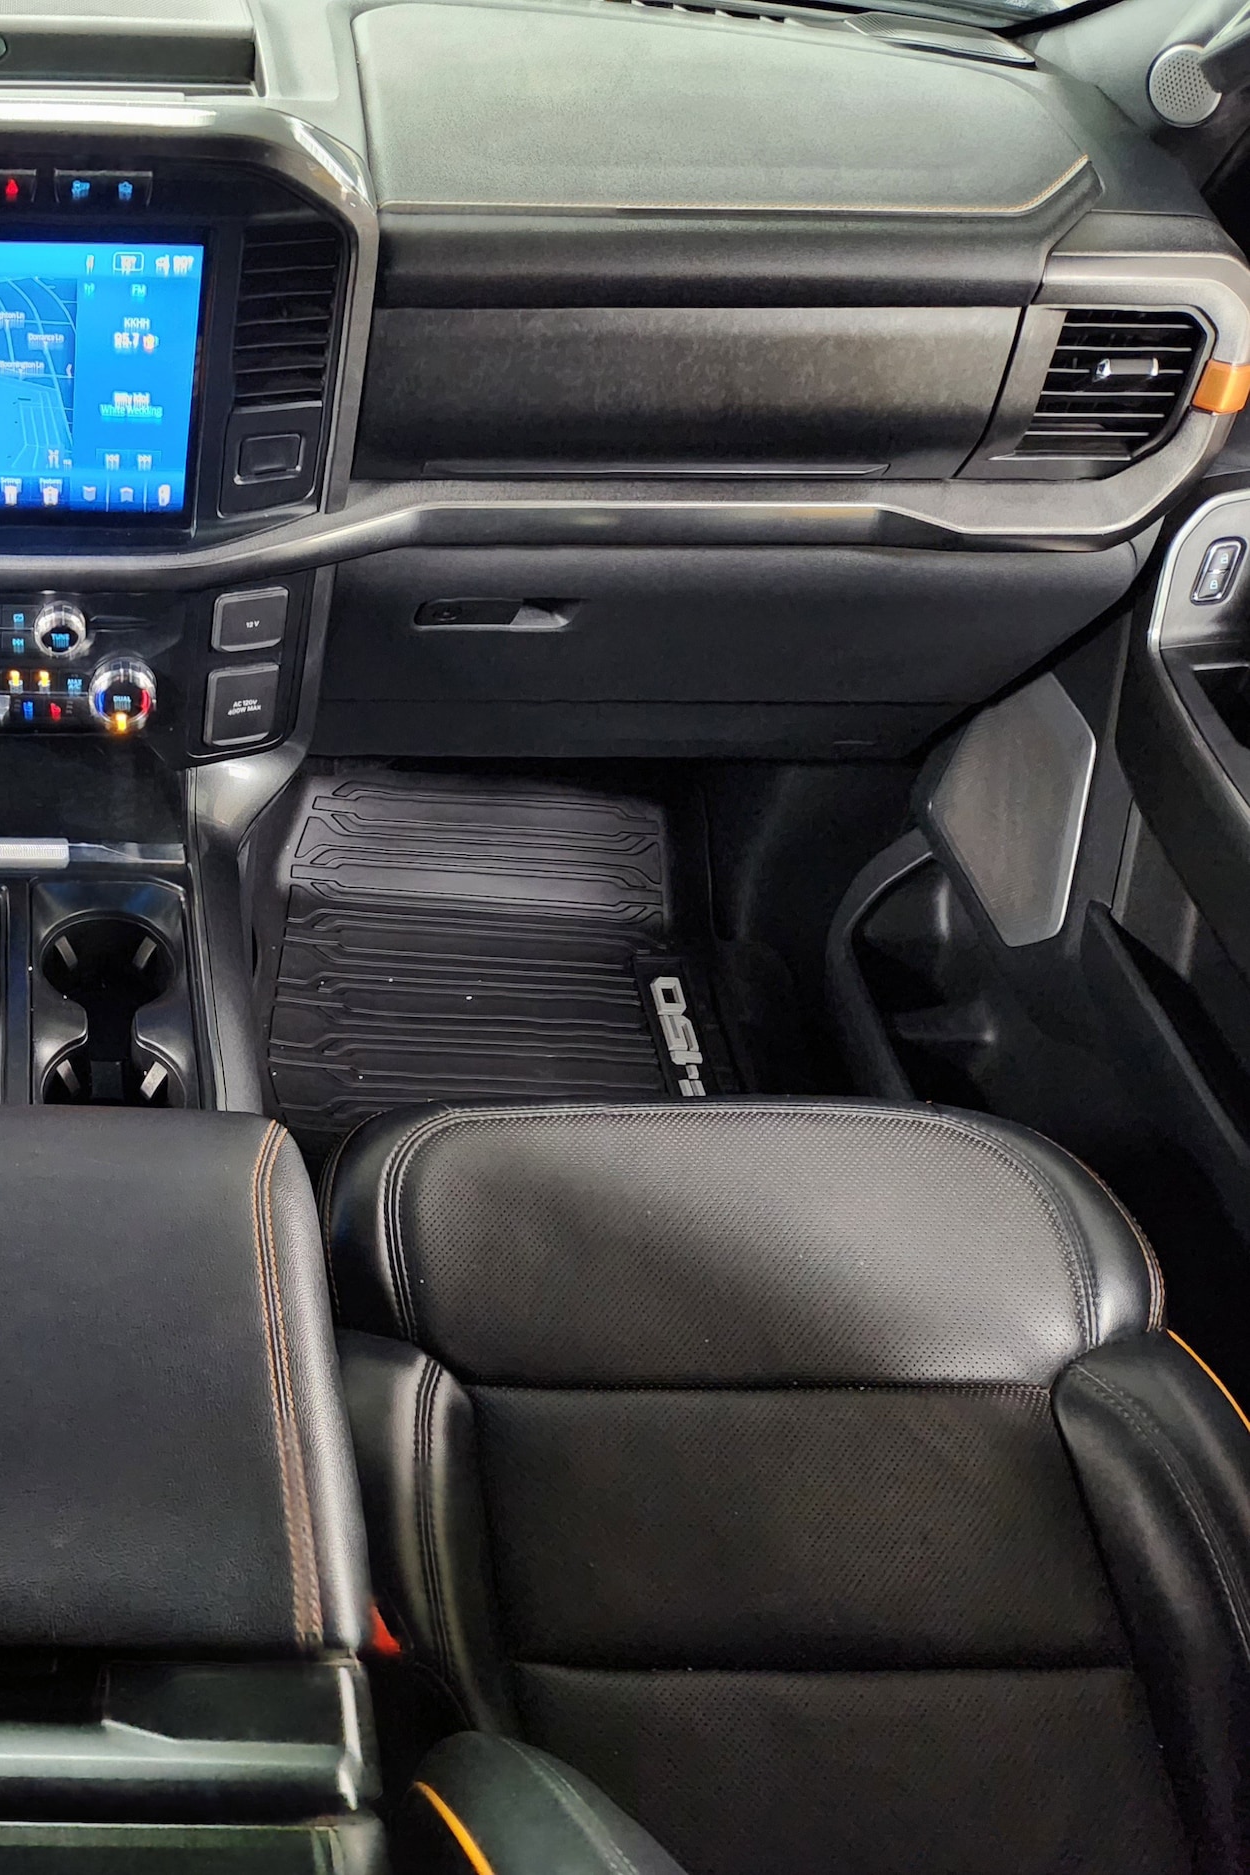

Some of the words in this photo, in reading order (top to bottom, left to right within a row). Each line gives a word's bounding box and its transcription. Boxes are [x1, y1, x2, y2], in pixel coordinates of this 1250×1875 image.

[132, 284, 146, 297] FM
[124, 318, 150, 330] KKHH
[99, 404, 126, 416] White
[126, 405, 163, 418] Wedding
